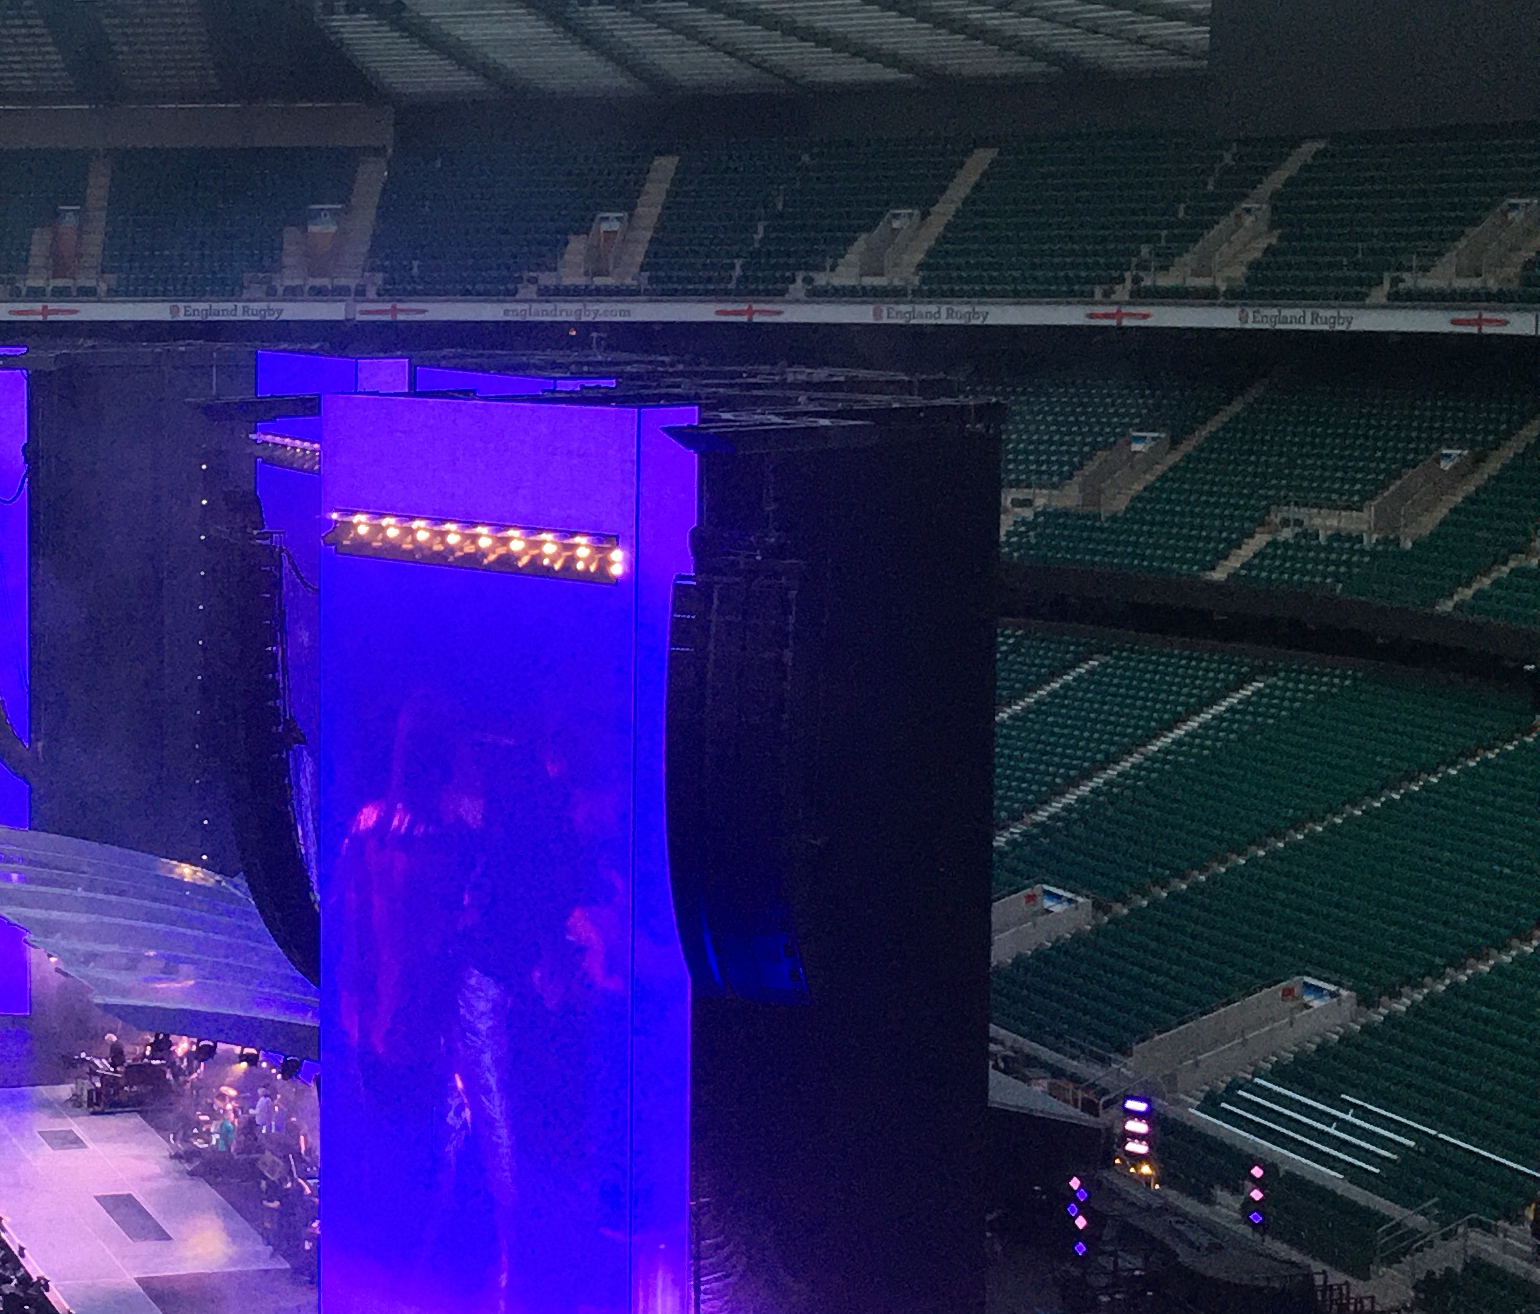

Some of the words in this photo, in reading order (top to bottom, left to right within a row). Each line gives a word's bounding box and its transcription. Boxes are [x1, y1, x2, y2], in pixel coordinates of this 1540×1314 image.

[183, 305, 237, 319] England
[241, 305, 284, 319] Rugby
[886, 306, 941, 321] England
[945, 307, 989, 322] Rugby
[1252, 312, 1307, 327] England
[1309, 313, 1354, 328] Rugby
